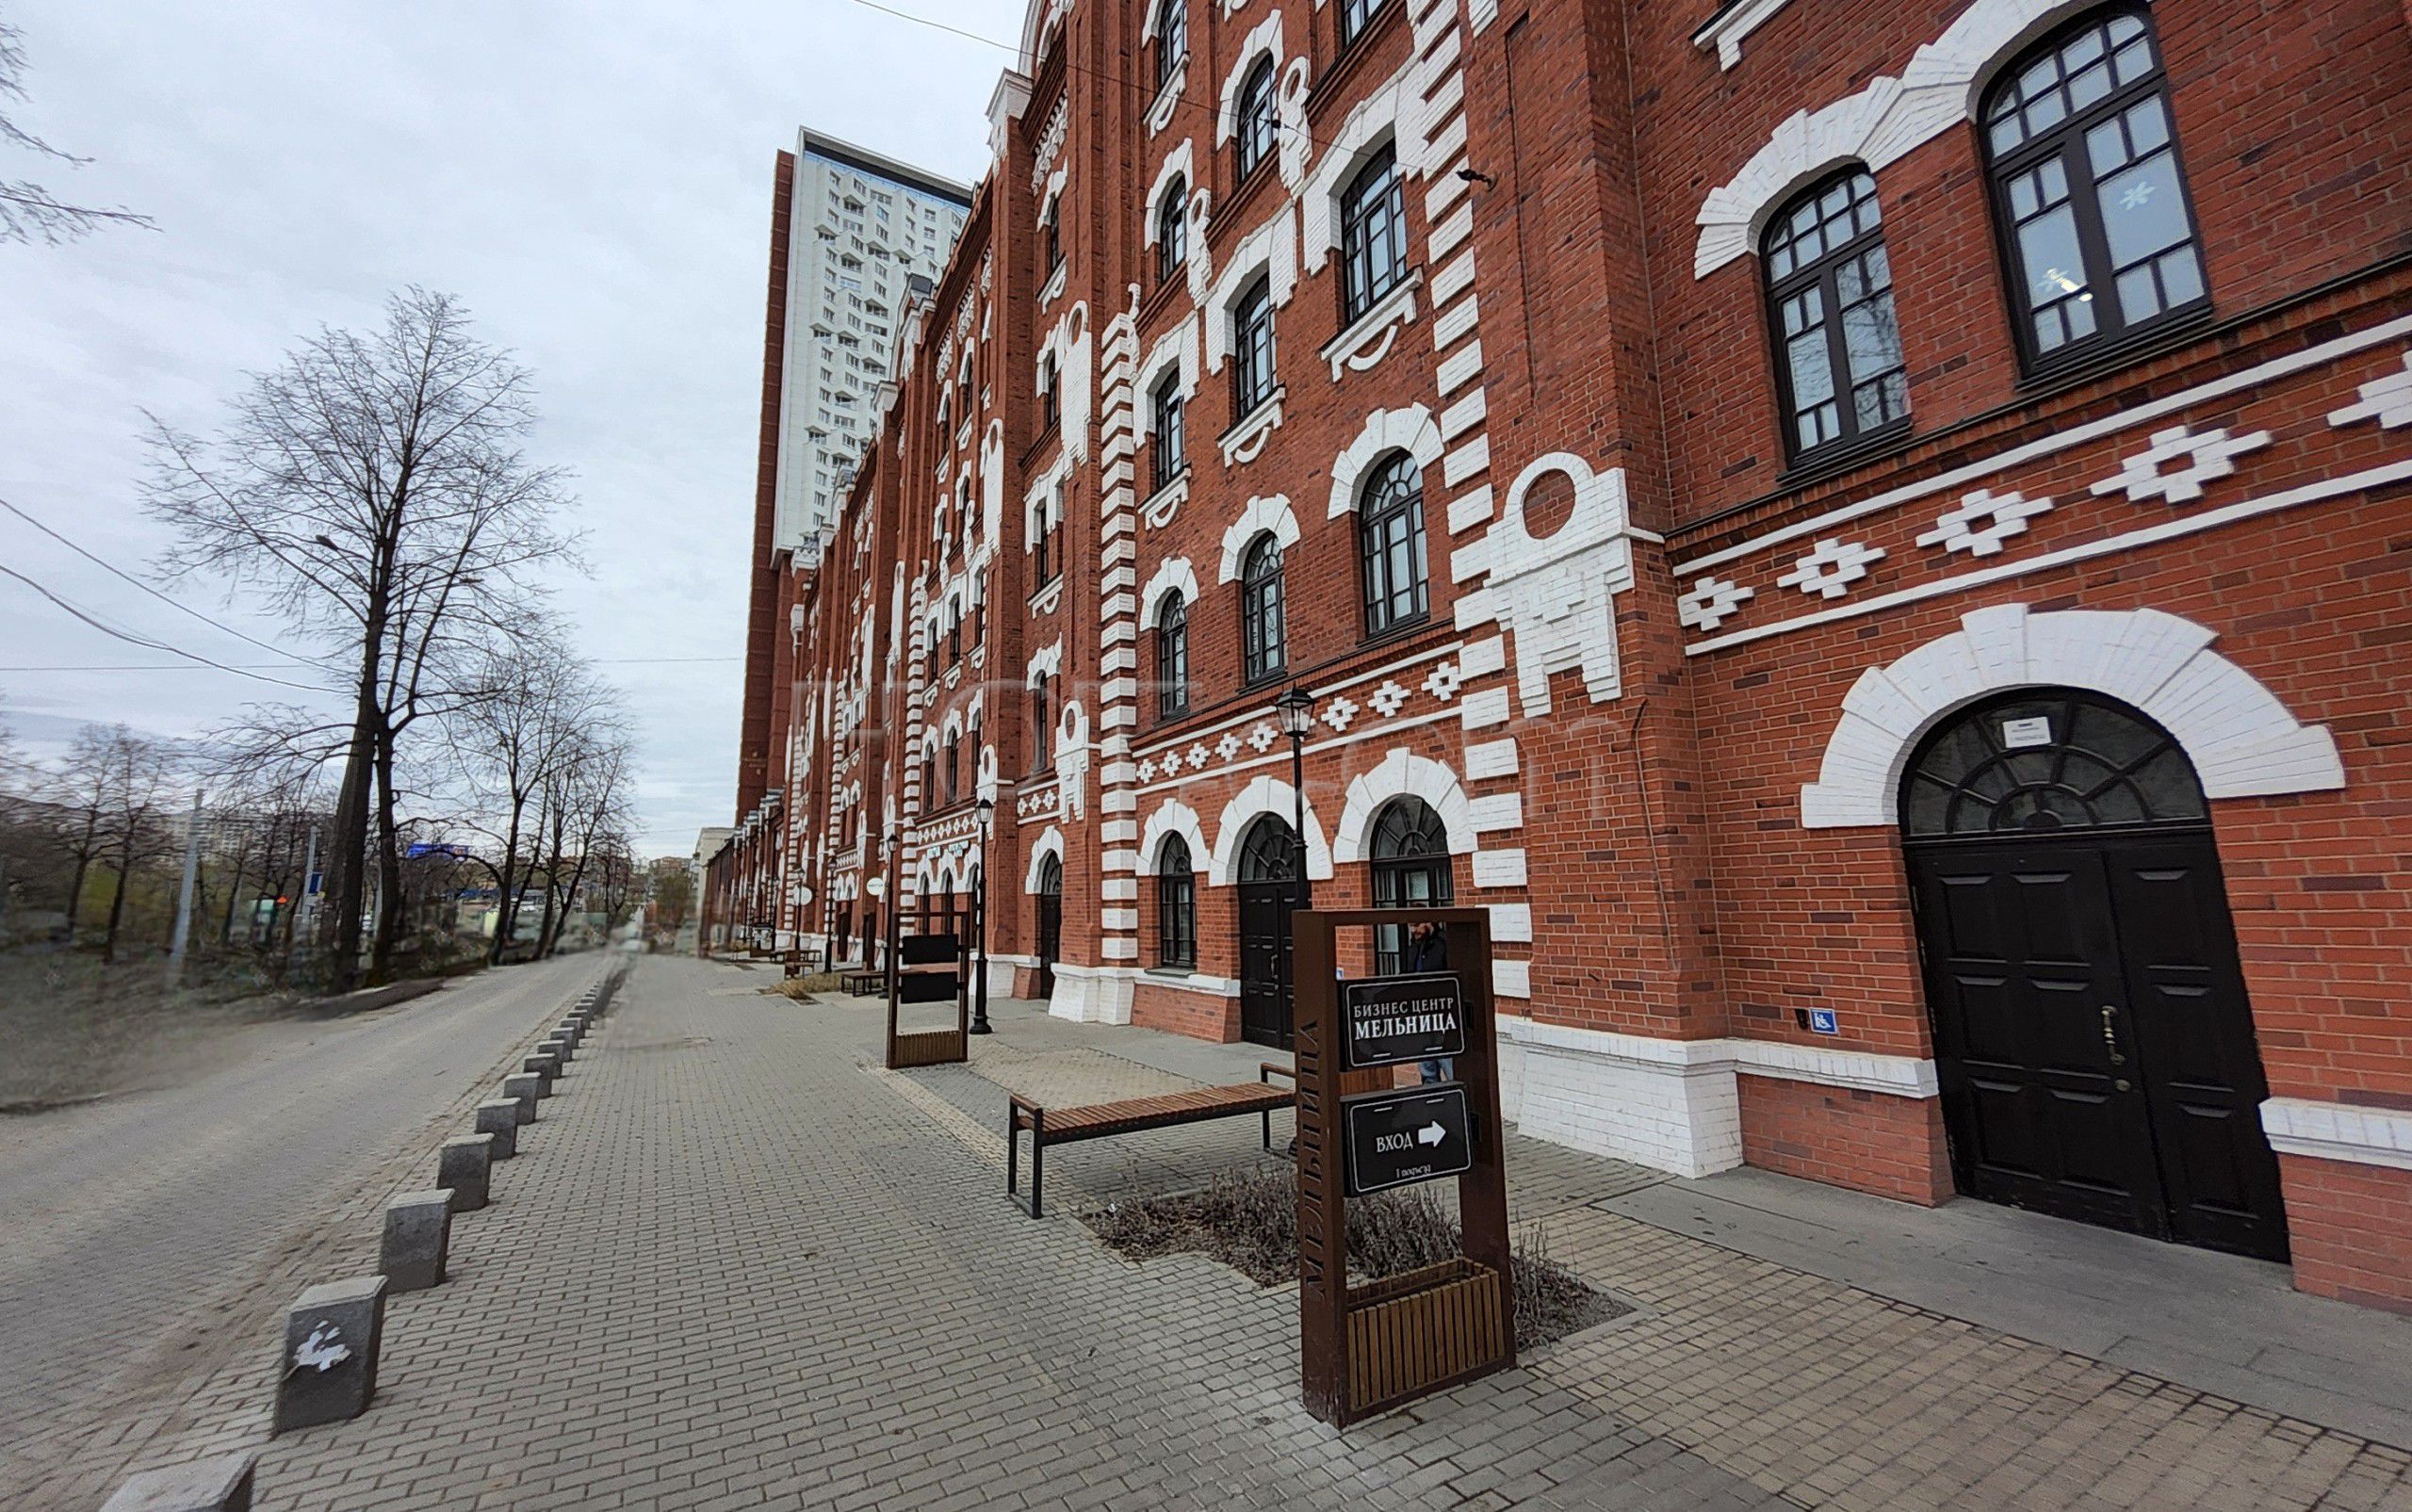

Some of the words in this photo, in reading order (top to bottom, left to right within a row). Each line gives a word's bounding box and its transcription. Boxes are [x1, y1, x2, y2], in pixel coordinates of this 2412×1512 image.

[1354, 1001, 1409, 1018] БИЗНЕС
[1411, 998, 1454, 1014] ЦЕНТР
[1354, 1013, 1457, 1040] МЕЛЬНИЦА
[1376, 1131, 1413, 1153] ВХОД
